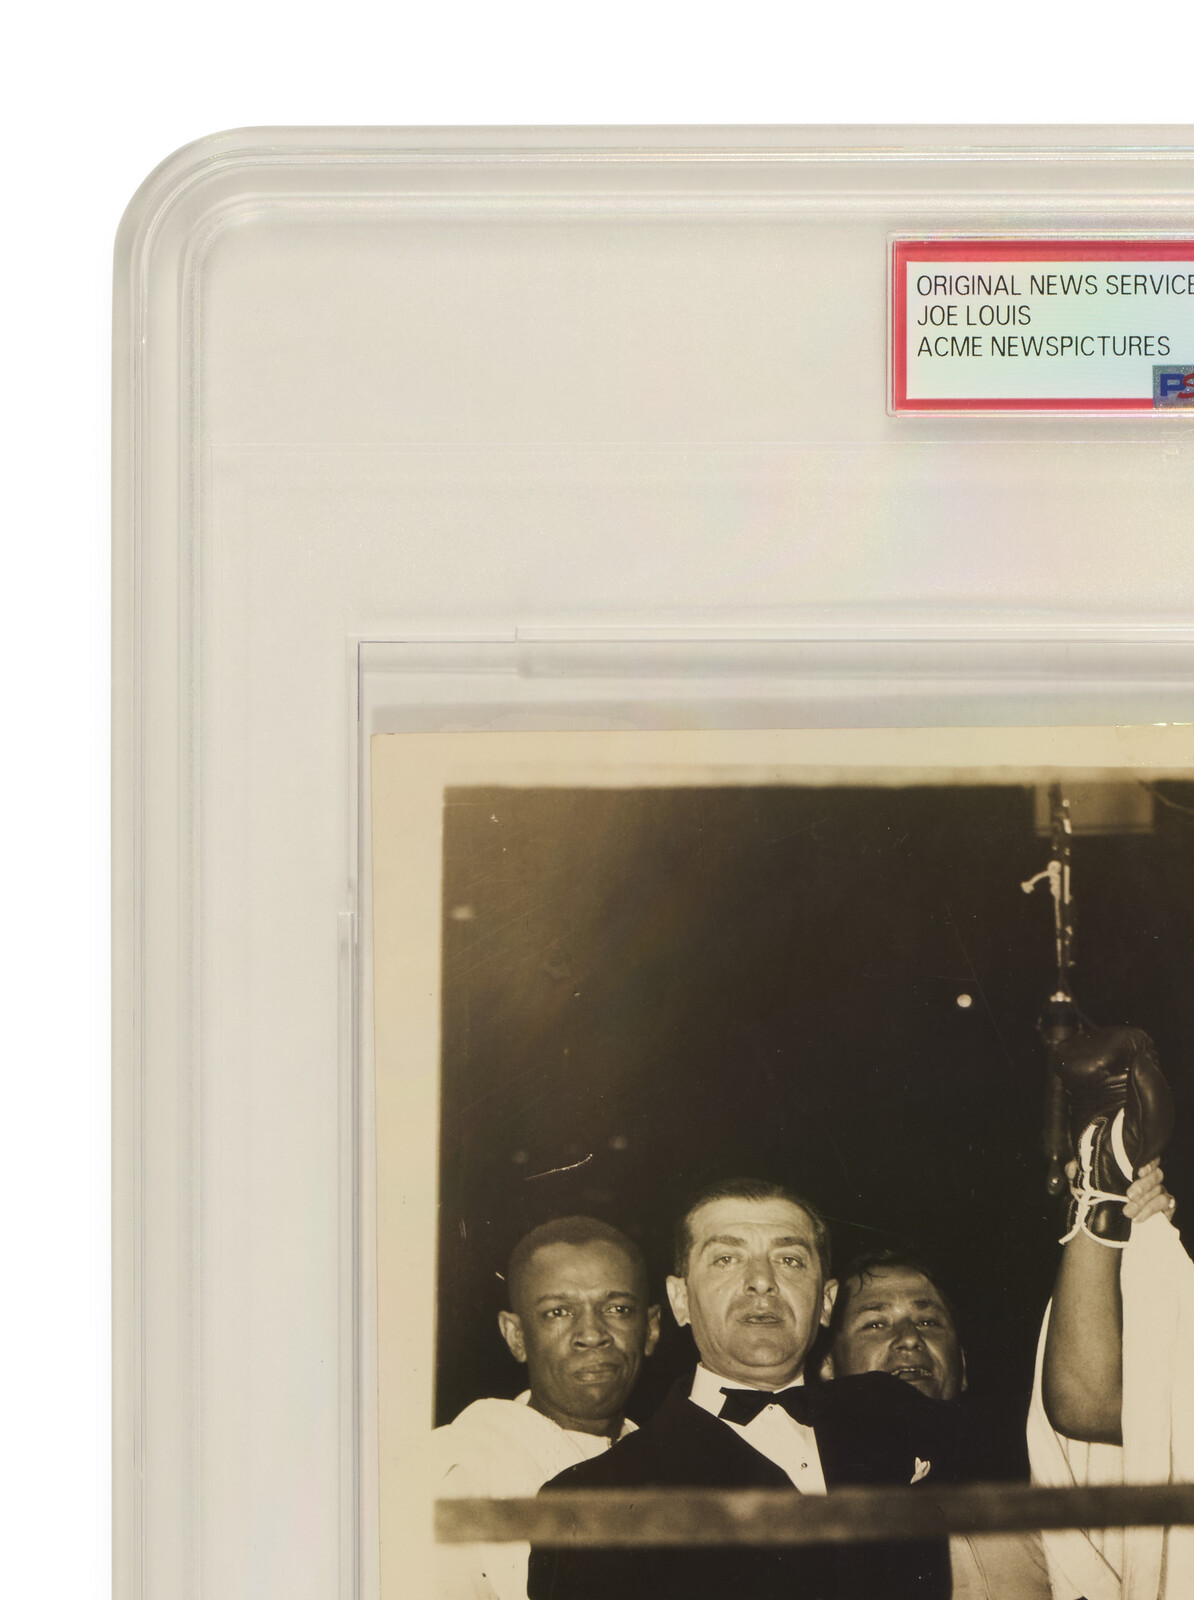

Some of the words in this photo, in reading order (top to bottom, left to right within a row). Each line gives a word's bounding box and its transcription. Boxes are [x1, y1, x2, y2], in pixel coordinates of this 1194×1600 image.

[917, 273, 1022, 296] ORIGINAL
[1030, 273, 1098, 296] NEWS
[917, 304, 958, 327] JOE
[966, 304, 1031, 327] LOUIS
[917, 335, 983, 357] ACME
[991, 335, 1171, 357] NEWSPICTURES
